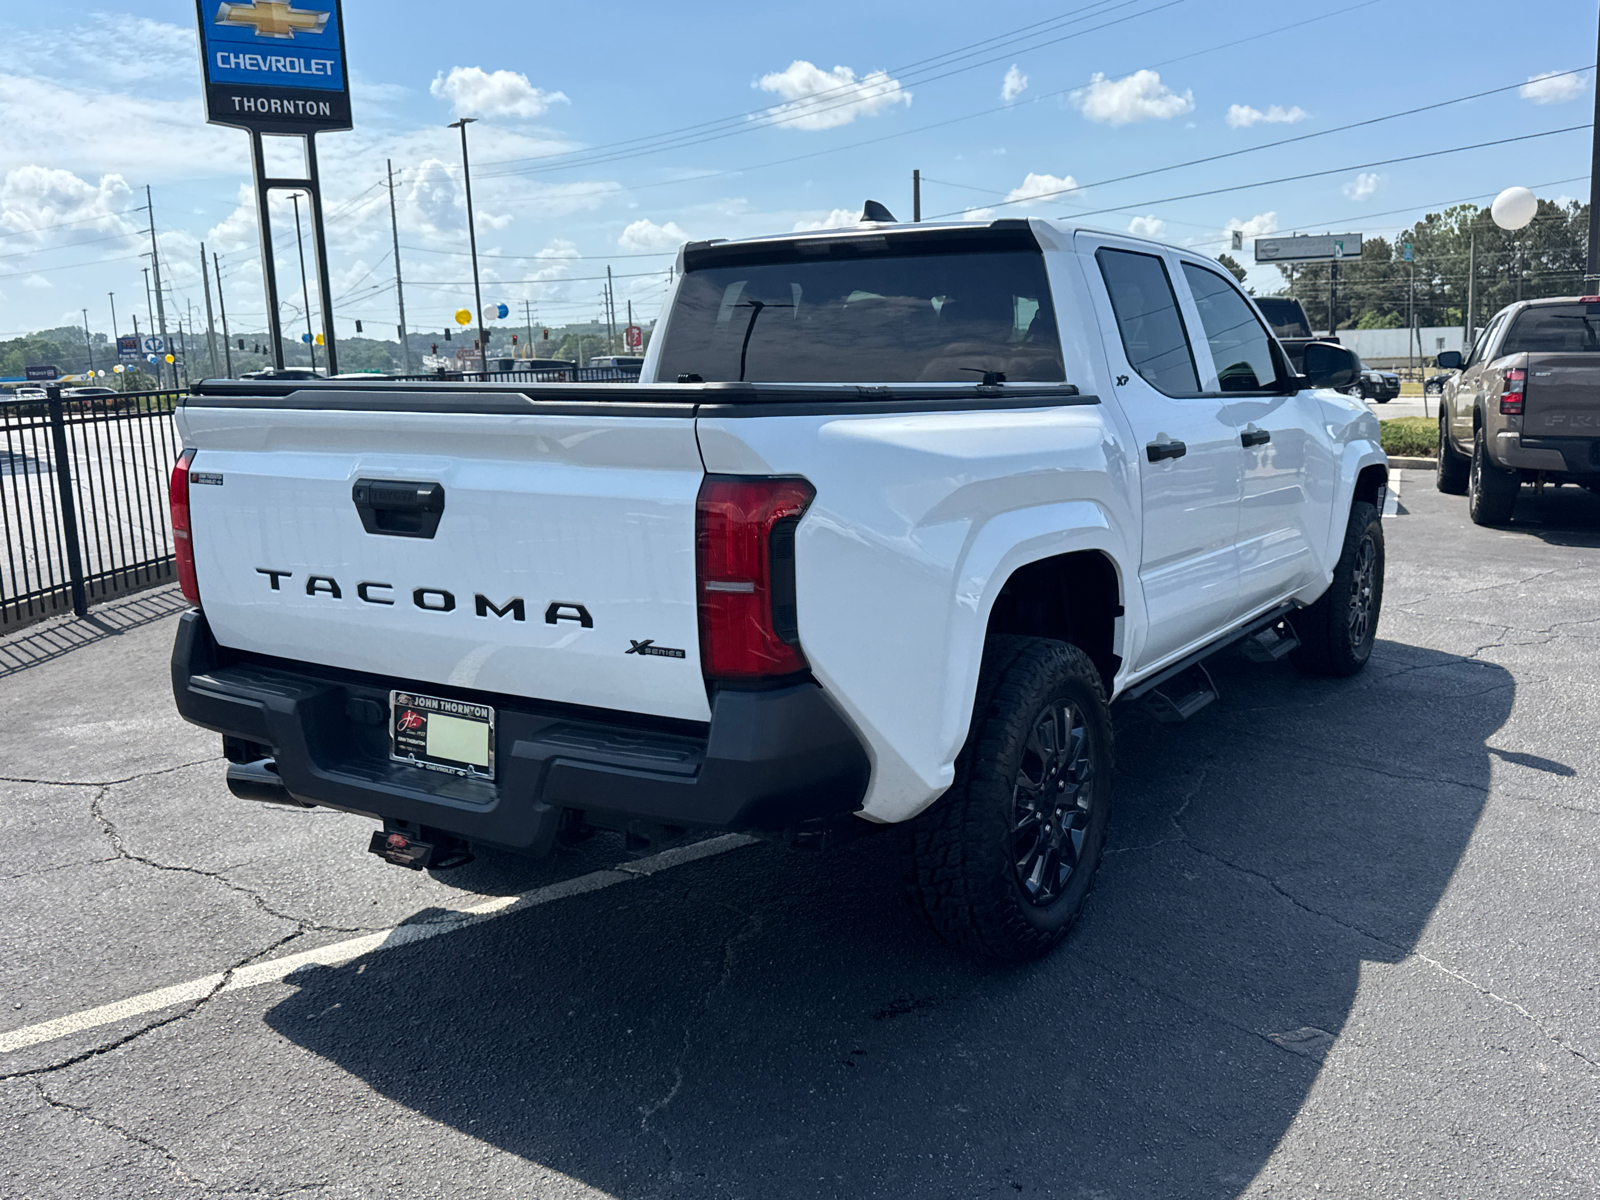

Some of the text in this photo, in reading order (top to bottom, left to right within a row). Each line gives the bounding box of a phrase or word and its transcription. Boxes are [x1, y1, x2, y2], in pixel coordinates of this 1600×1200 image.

[216, 52, 335, 76] CHEVROLET
[231, 96, 331, 116] THORNTON
[1544, 415, 1600, 427] FR
[255, 567, 594, 629] TACOMA
[645, 647, 683, 658] SERIES
[414, 696, 488, 718] JOHN THORNTON
[425, 763, 456, 775] CHEVROLET
